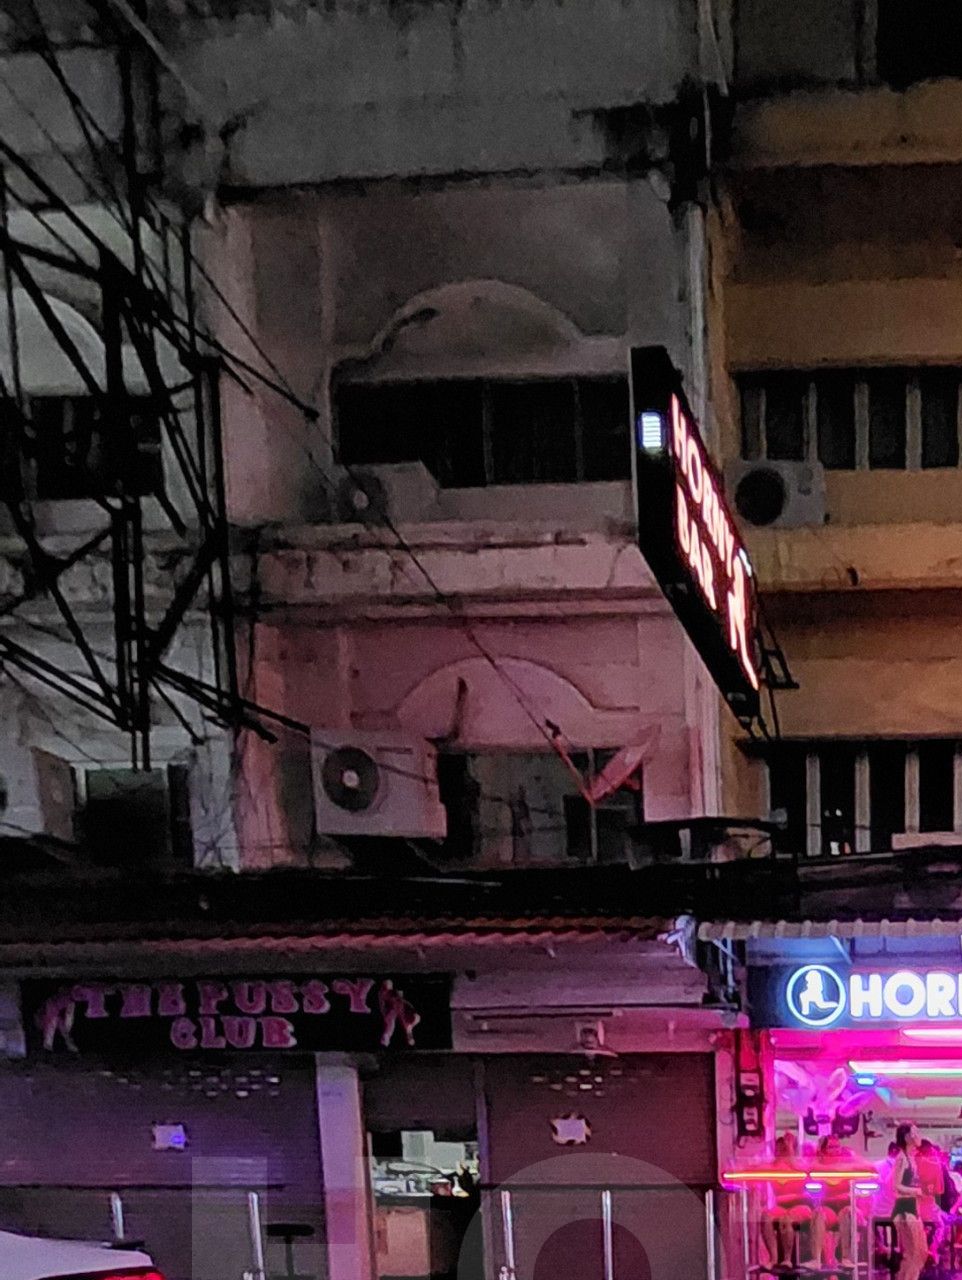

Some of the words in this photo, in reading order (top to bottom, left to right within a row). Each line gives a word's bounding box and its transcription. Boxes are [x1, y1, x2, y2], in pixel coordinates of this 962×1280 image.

[671, 392, 735, 578] HORNY
[676, 483, 716, 610] BAR
[170, 1016, 297, 1049] CLUB
[198, 980, 375, 1013] PUSSY
